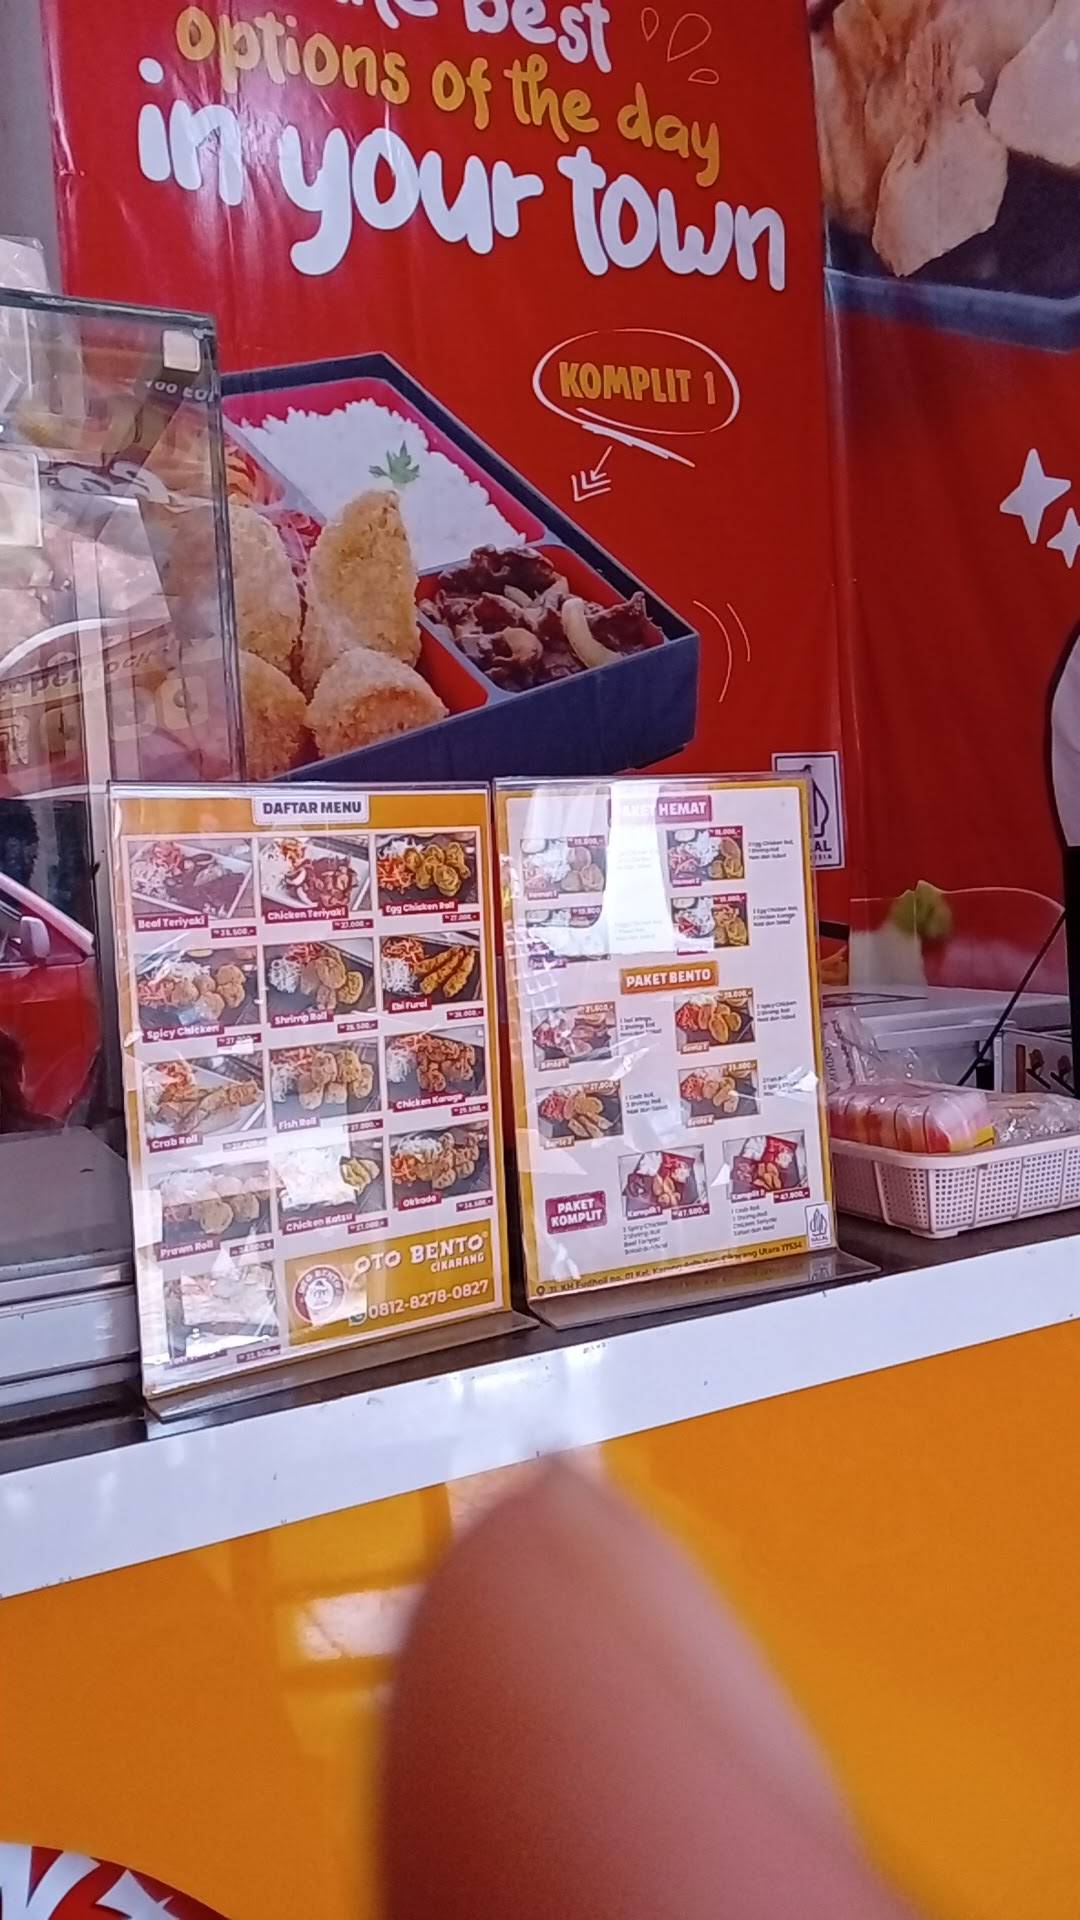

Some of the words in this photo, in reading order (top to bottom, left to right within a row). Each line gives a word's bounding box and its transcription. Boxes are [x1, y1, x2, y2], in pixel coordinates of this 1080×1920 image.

[464, 0, 612, 73] best
[176, 6, 410, 104] options
[432, 57, 492, 130] of
[504, 53, 600, 143] the
[617, 82, 721, 187] day
[138, 57, 242, 206] in
[279, 127, 544, 276] your
[558, 146, 786, 292] town
[559, 361, 692, 403] KOMPLIT
[703, 371, 716, 404] 1
[263, 802, 318, 814] DAFTAR
[321, 801, 362, 813] MENU
[659, 802, 706, 816] HEMAT
[267, 909, 306, 920] Chicken
[308, 907, 346, 918] Teriyaki
[385, 905, 403, 914] Egg
[404, 902, 438, 912] Chicken
[163, 916, 205, 928] Teriyaki
[626, 973, 668, 987] PAKET
[669, 969, 711, 983] BENTO
[275, 1013, 308, 1026] Shrimp
[310, 1012, 327, 1021] Roll
[147, 1030, 175, 1041] Spicy
[177, 1026, 219, 1036] Chicken
[396, 1097, 432, 1109] Chicken
[279, 1119, 298, 1130] Fish
[151, 1138, 178, 1149] Crab
[179, 1134, 199, 1145] Roll
[558, 1199, 594, 1213] PAKET
[286, 1217, 324, 1231] Chicken
[325, 1213, 352, 1225] Katsu
[551, 1209, 602, 1227] KOMPLIT
[354, 1250, 401, 1273] OTO
[410, 1234, 483, 1263] BENTO
[759, 1245, 780, 1255] Utara
[431, 1252, 485, 1272] CIKARANG
[367, 1279, 489, 1319] 0812-8278-0827
